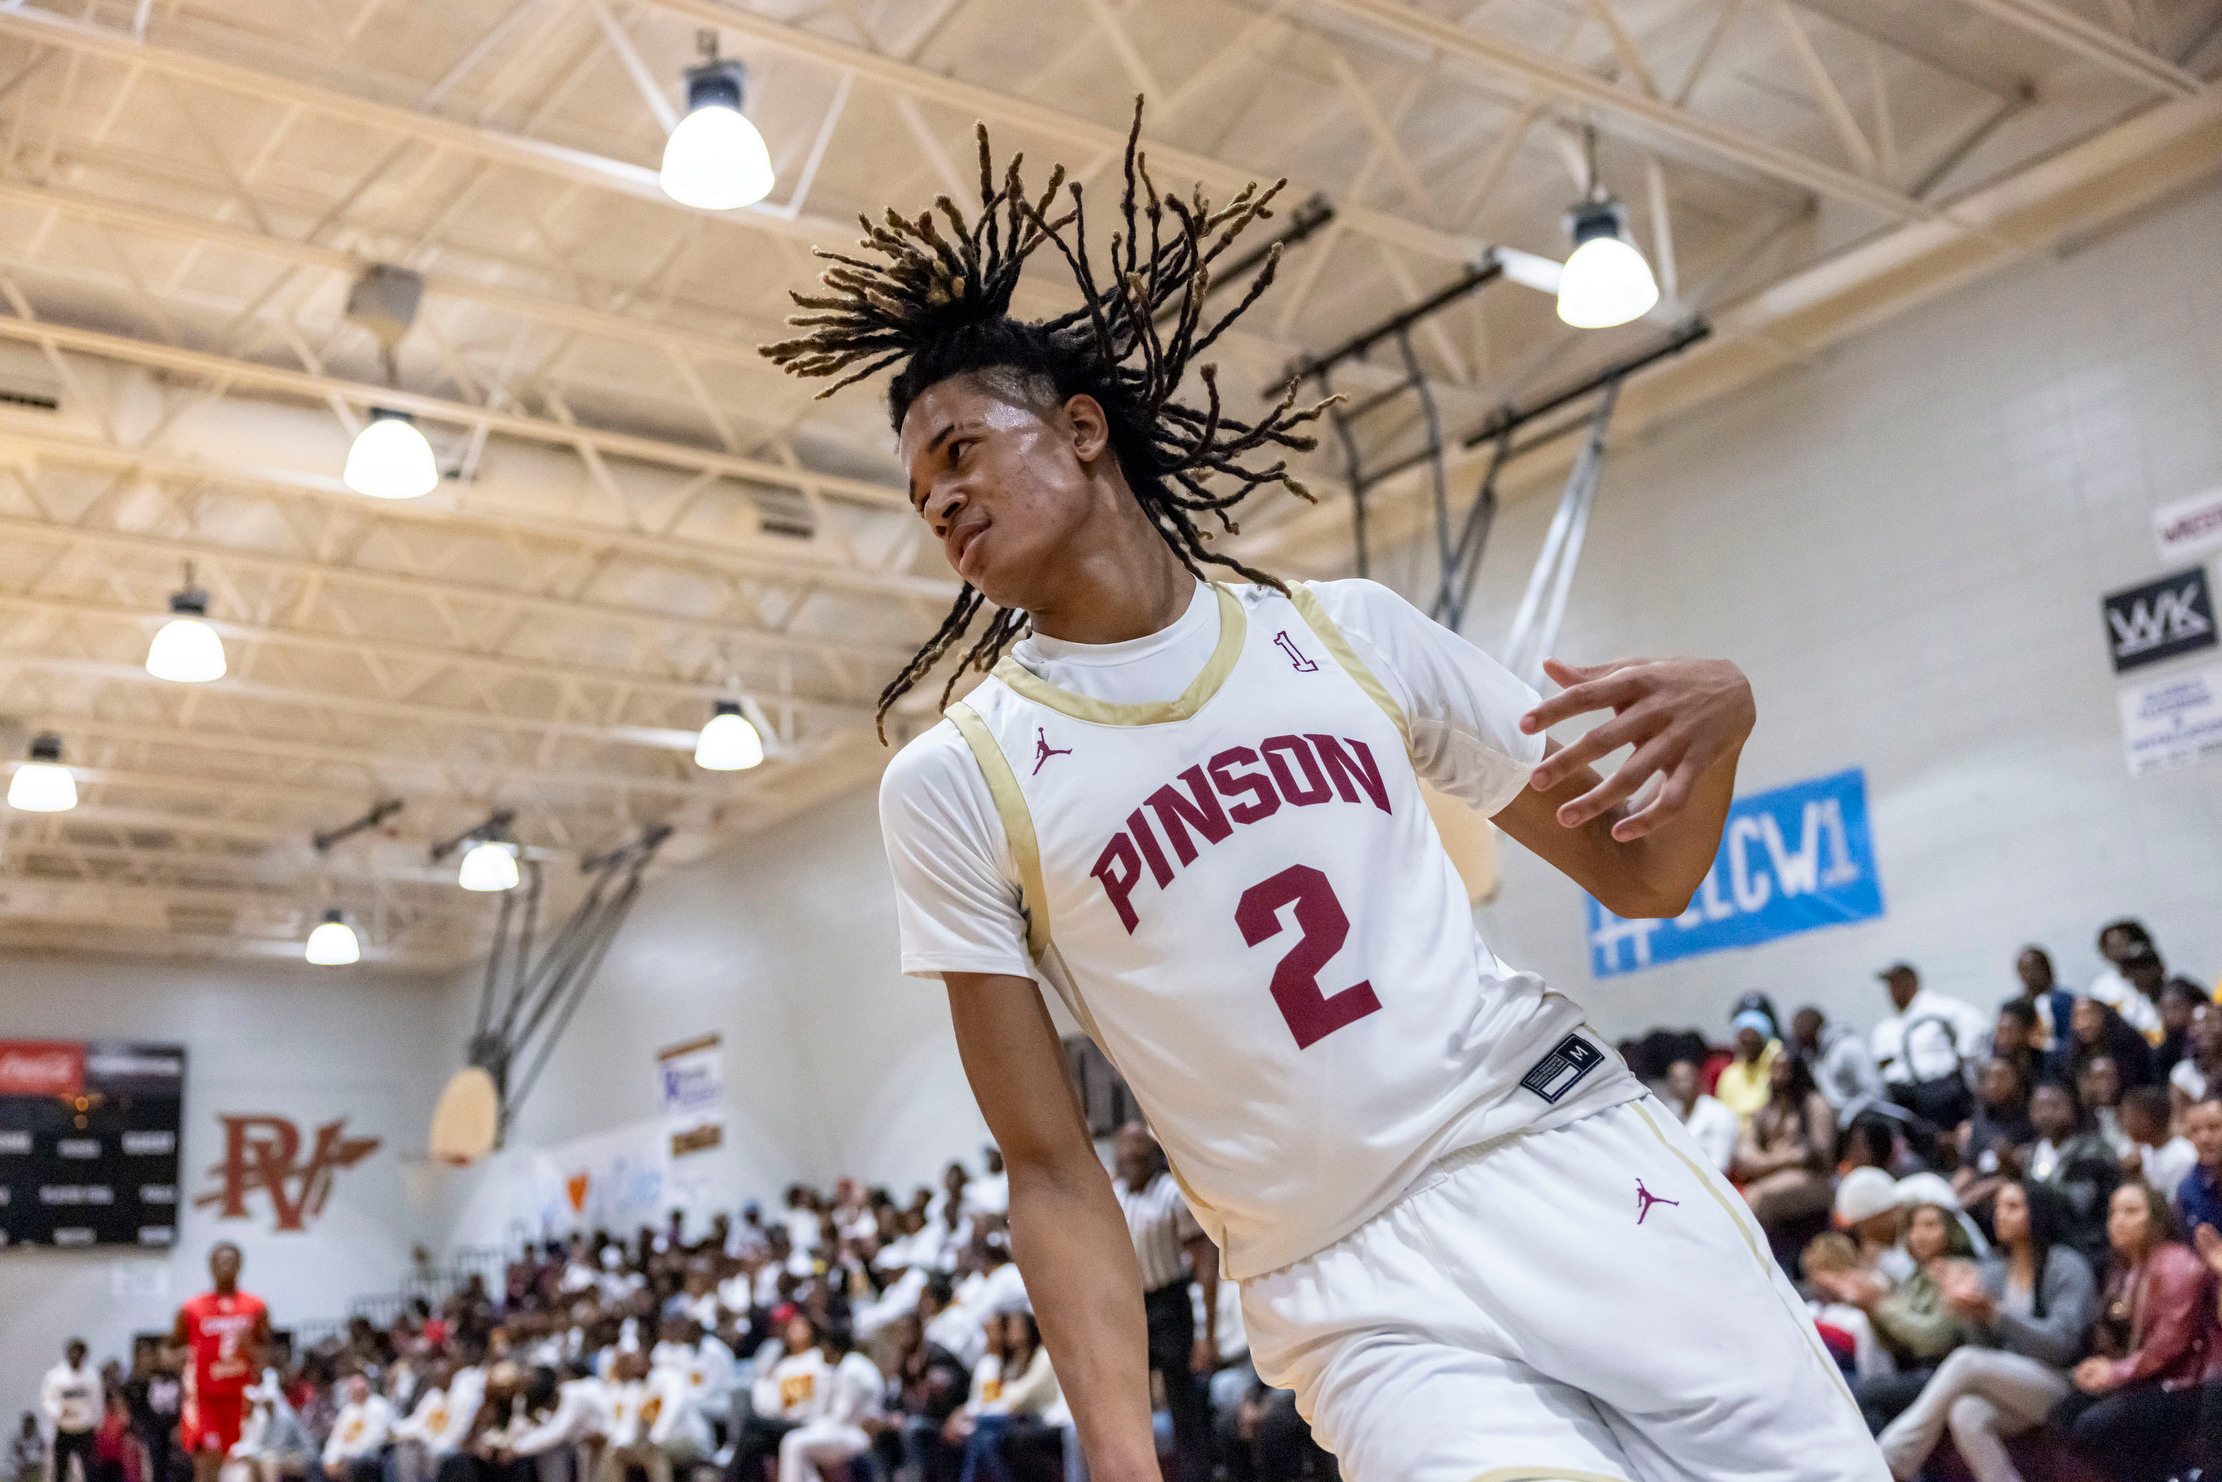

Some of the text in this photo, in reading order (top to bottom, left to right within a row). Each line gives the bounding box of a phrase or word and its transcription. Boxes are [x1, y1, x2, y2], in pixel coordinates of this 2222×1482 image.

[1273, 630, 1319, 672] 1
[1090, 733, 1392, 937] PINSON
[1234, 863, 1383, 1051] 2
[1569, 1045, 1589, 1061] M
